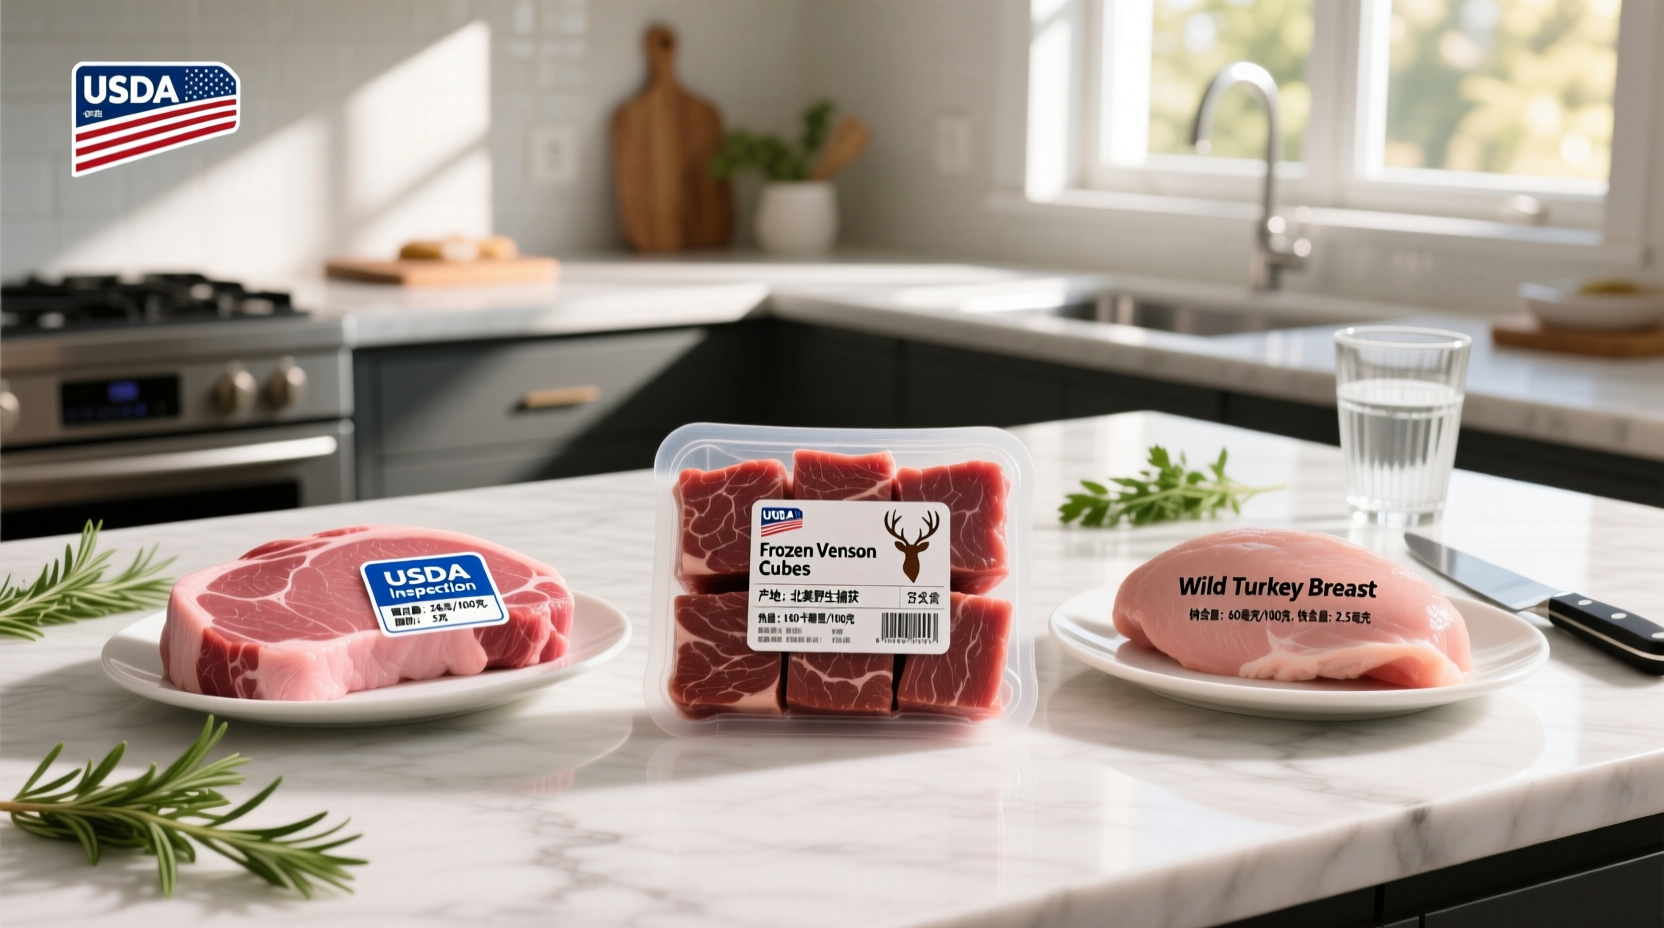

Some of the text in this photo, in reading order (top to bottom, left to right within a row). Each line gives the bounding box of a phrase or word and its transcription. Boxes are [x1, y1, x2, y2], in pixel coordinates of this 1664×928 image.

[760, 542, 877, 559] Frozen Venson
[383, 563, 471, 587] USDA
[759, 560, 811, 576] Cubes
[1179, 575, 1378, 602] Wild Turkey Breast
